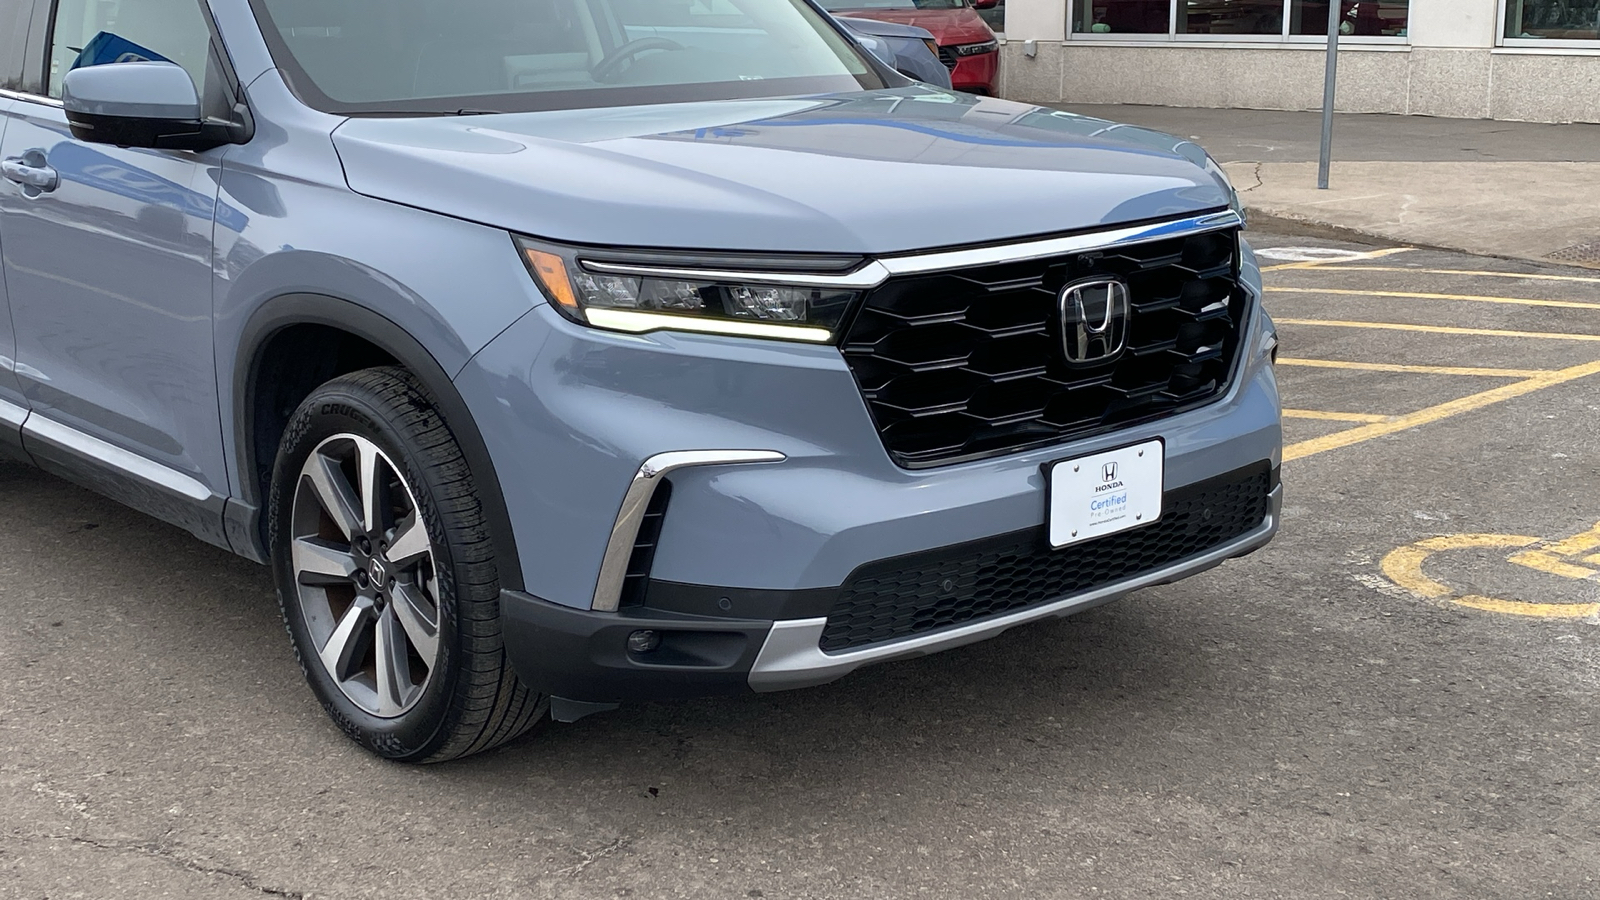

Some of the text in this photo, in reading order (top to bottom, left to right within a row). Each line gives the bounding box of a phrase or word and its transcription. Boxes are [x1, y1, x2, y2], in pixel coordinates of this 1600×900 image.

[321, 403, 382, 435] CRUGEN
[1095, 481, 1124, 492] HONDA
[1090, 492, 1127, 511] Certified
[1090, 505, 1126, 518] Pre-Owned
